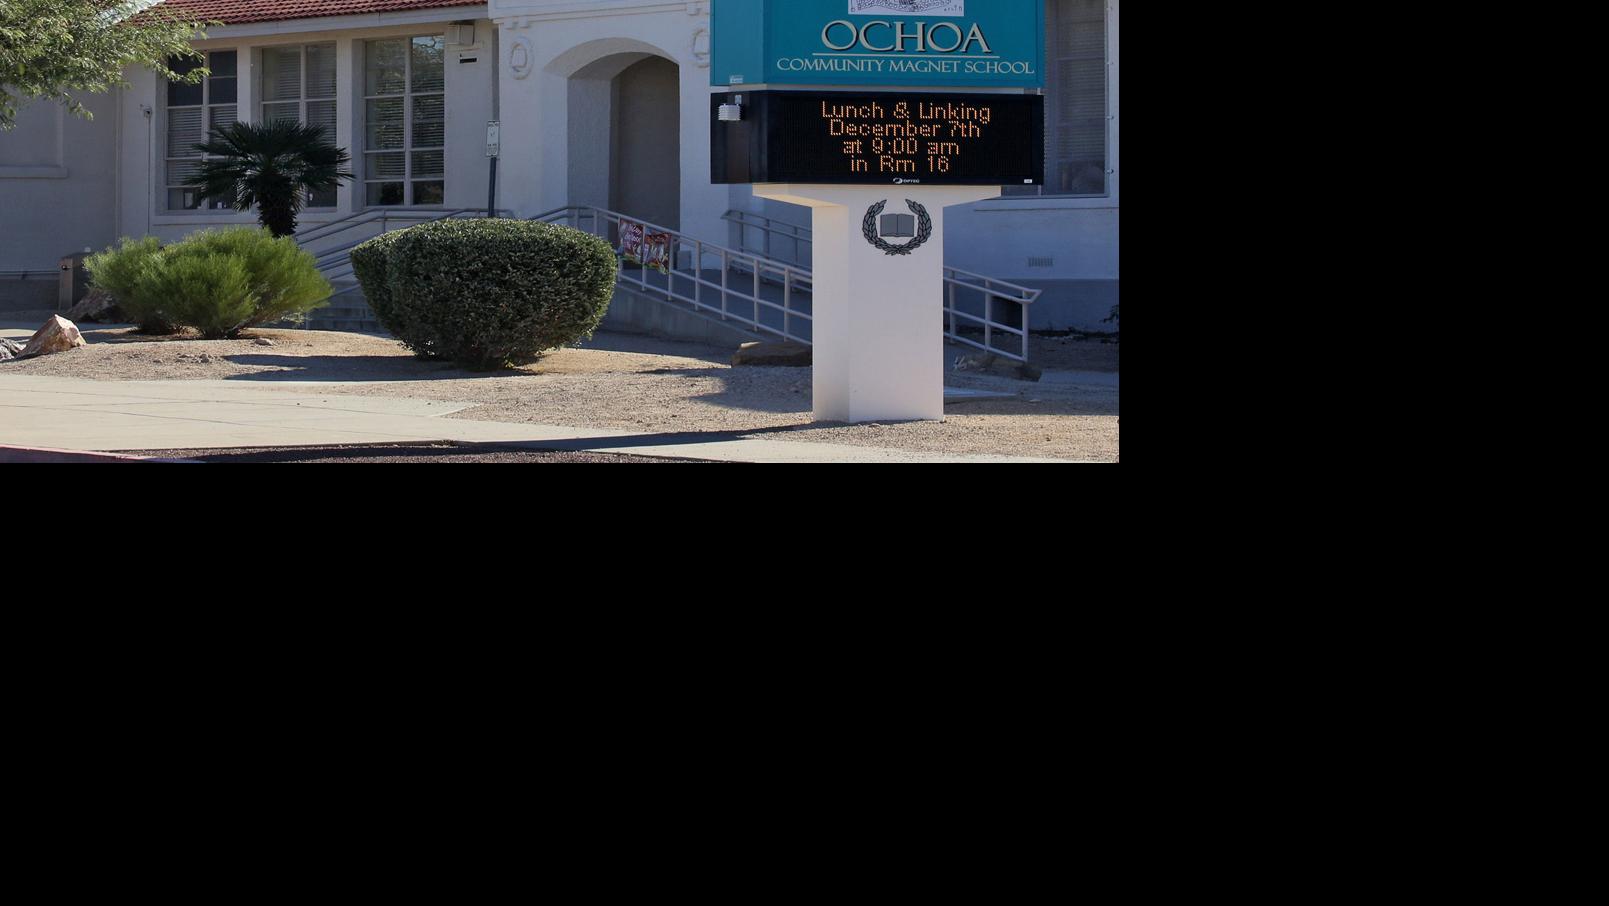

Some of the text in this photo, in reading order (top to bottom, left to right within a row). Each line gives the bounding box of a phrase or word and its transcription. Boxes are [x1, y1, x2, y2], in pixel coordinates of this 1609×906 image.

[821, 20, 991, 53] OCHOA
[776, 58, 1035, 75] COMMUNITY MAGNET SCHOOL
[822, 101, 991, 124] Lunch & Linking
[830, 119, 980, 138] December 7th
[843, 137, 960, 155] at 9:00 am
[851, 154, 949, 172] in Rm 16
